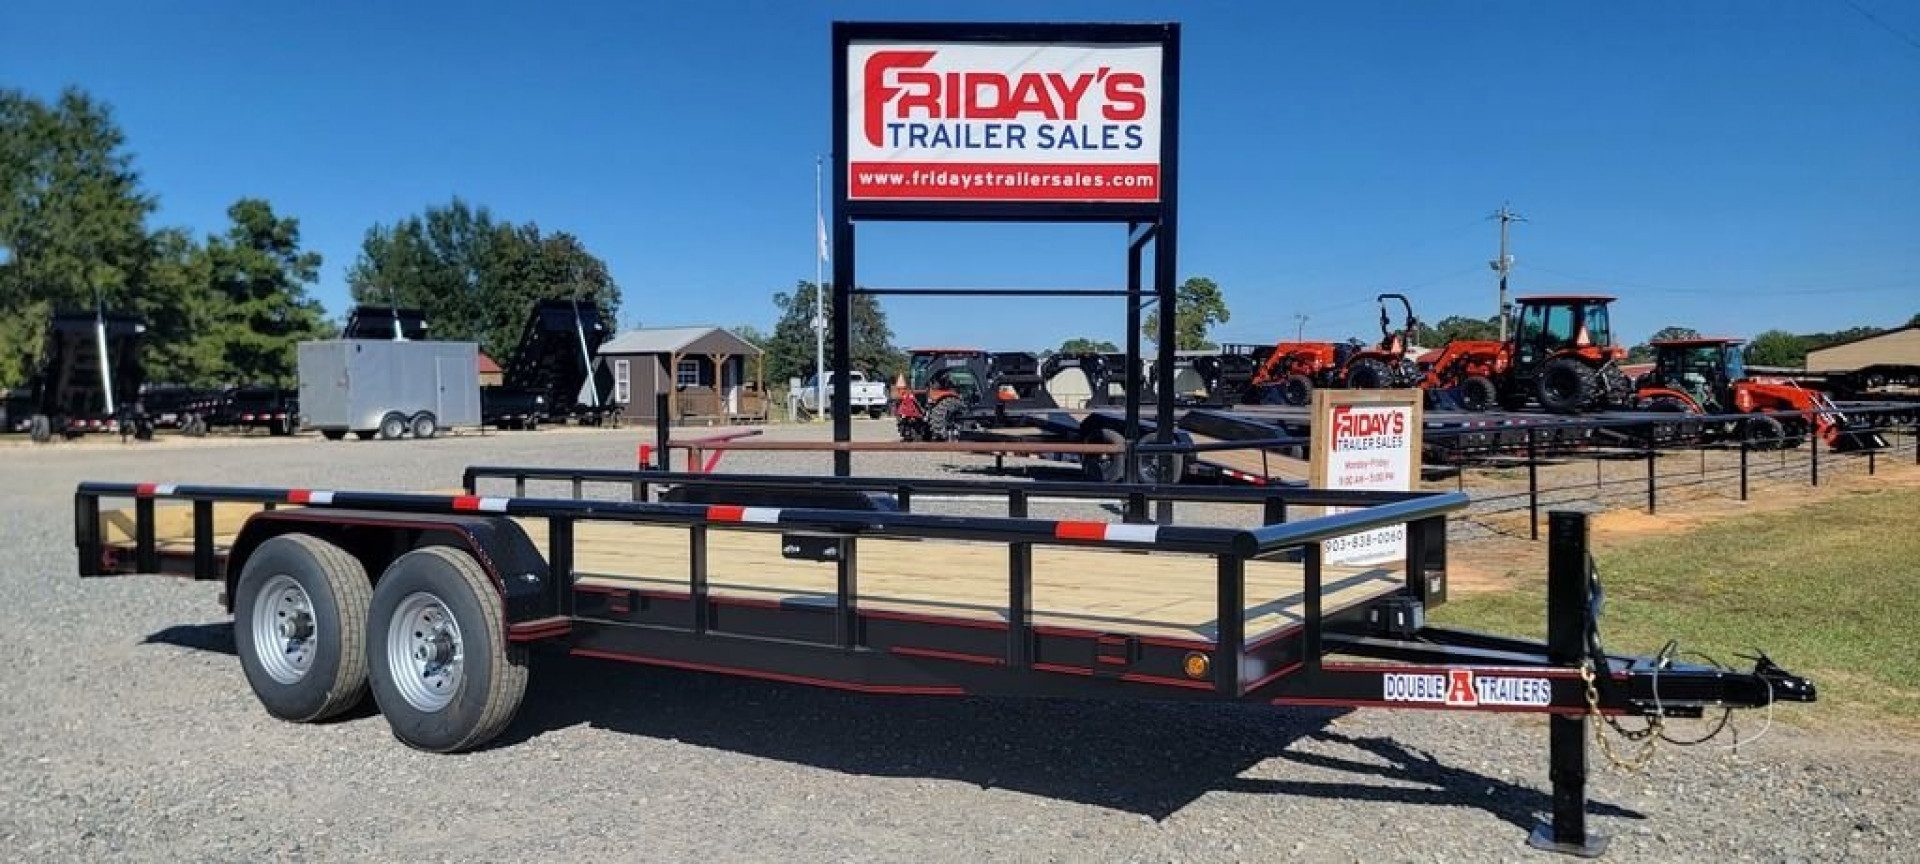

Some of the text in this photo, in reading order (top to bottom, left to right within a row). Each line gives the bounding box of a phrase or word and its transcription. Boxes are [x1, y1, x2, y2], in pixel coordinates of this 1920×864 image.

[864, 51, 1146, 148] FRIDAY'S
[887, 123, 1143, 150] TRAILER SALES
[859, 170, 1154, 189] www.fridaystrailersales.com
[1333, 405, 1404, 452] FRIDAY'S
[1338, 436, 1403, 451] TRAILER SALES
[1325, 530, 1403, 552] 903-838-0060
[1386, 672, 1551, 703] DOUBLE A TRAILERS
